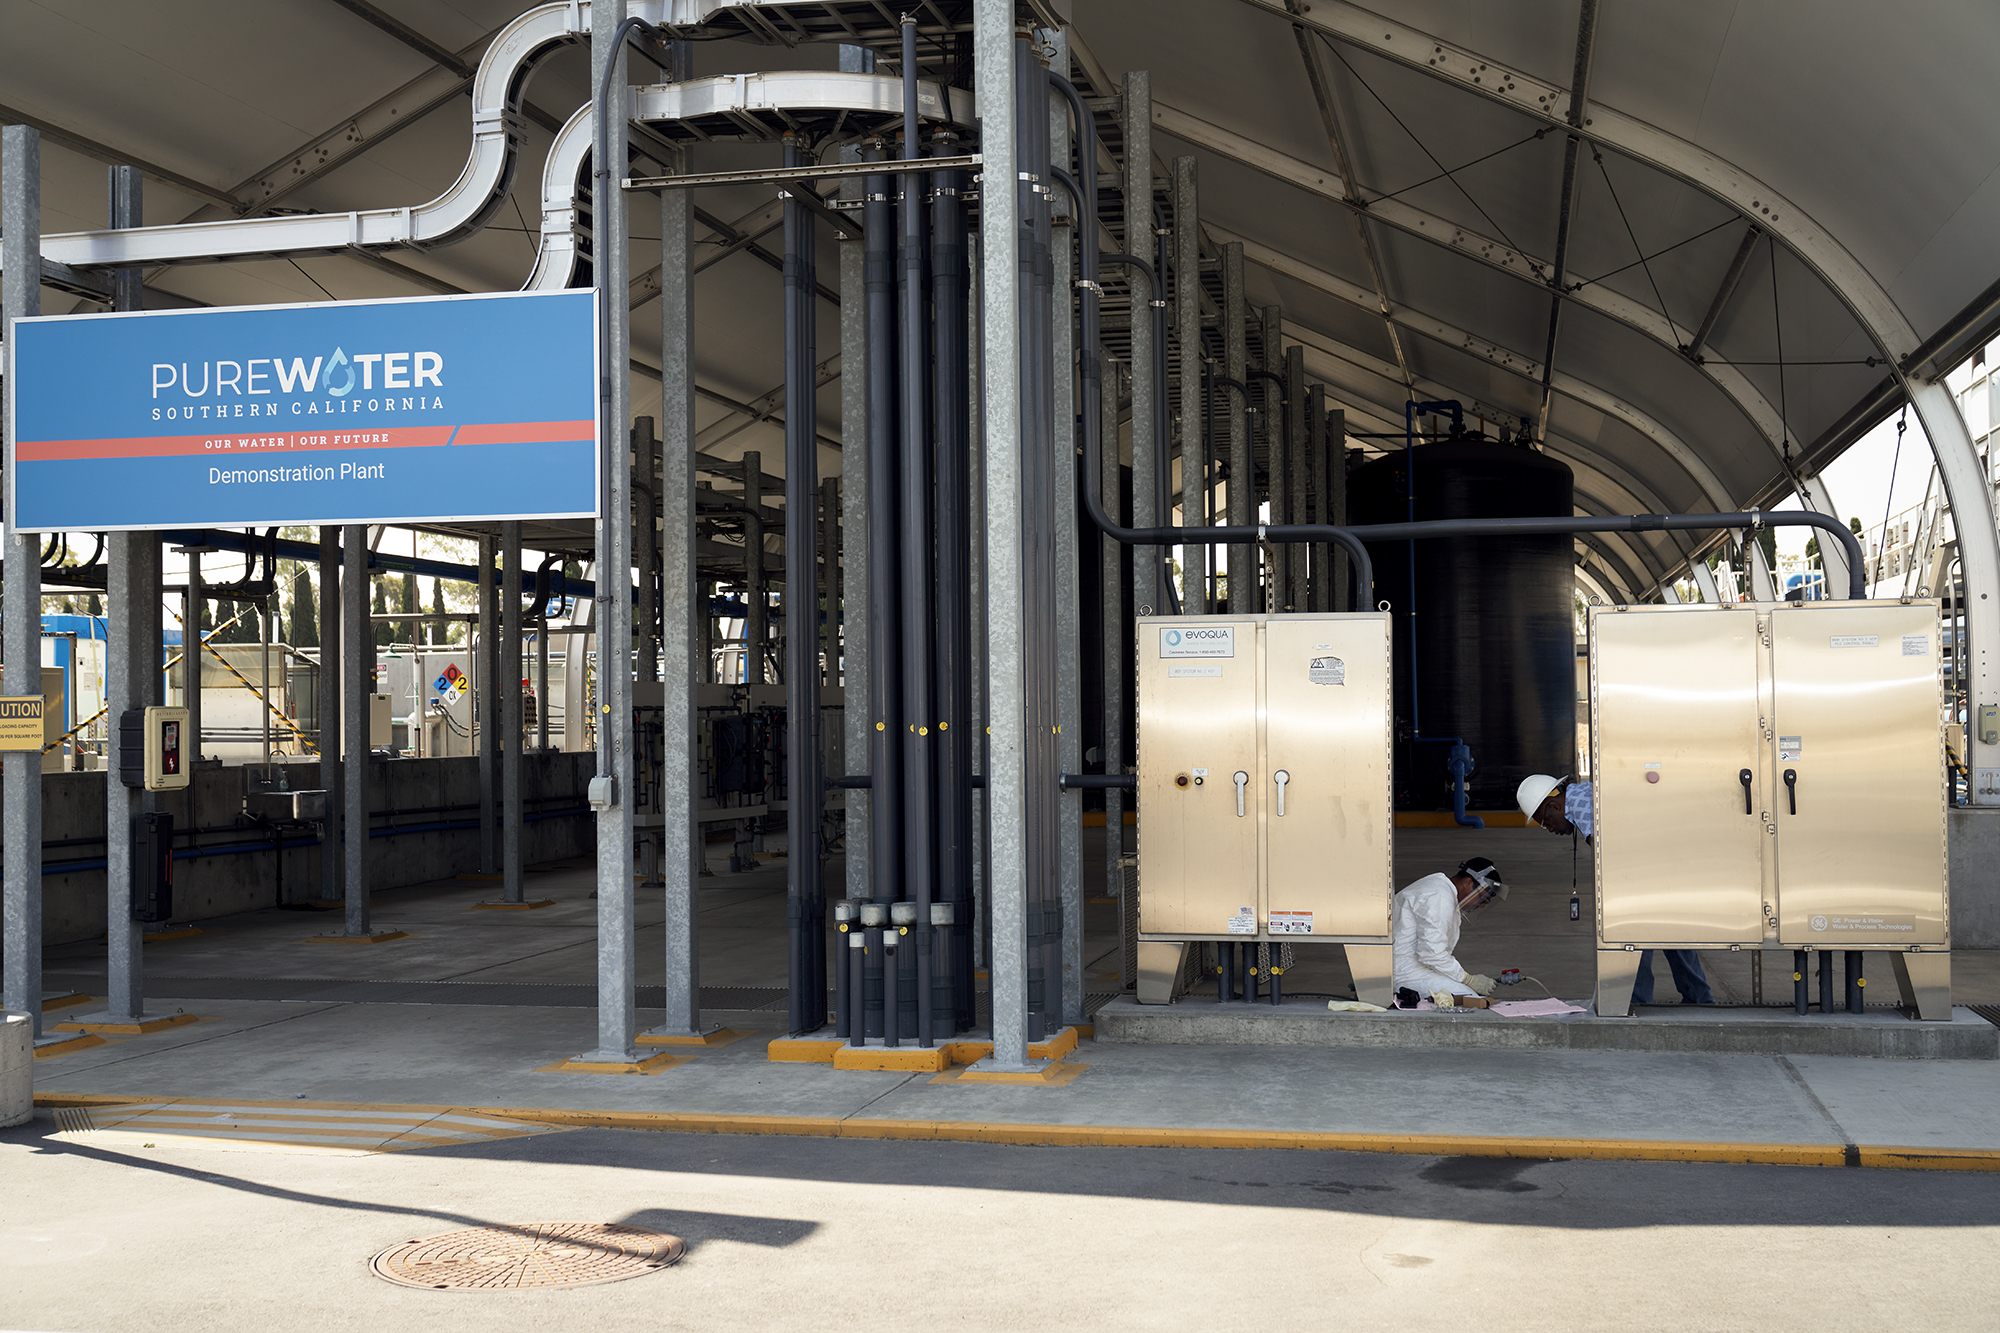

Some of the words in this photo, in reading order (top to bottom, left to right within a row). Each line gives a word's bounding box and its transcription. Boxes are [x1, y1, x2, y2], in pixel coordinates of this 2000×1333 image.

[152, 402, 278, 421] SOUTHERN
[291, 396, 444, 415] CALIFORNIA
[205, 438, 233, 449] OUR
[238, 437, 286, 448] WATER
[299, 435, 328, 446] OUR
[334, 433, 390, 444] FUTURE
[209, 464, 335, 484] Demonstration
[340, 462, 385, 481] Plant
[447, 667, 457, 681] 0
[438, 677, 447, 690] 2
[458, 677, 467, 690] 2
[0, 703, 40, 717] UTION
